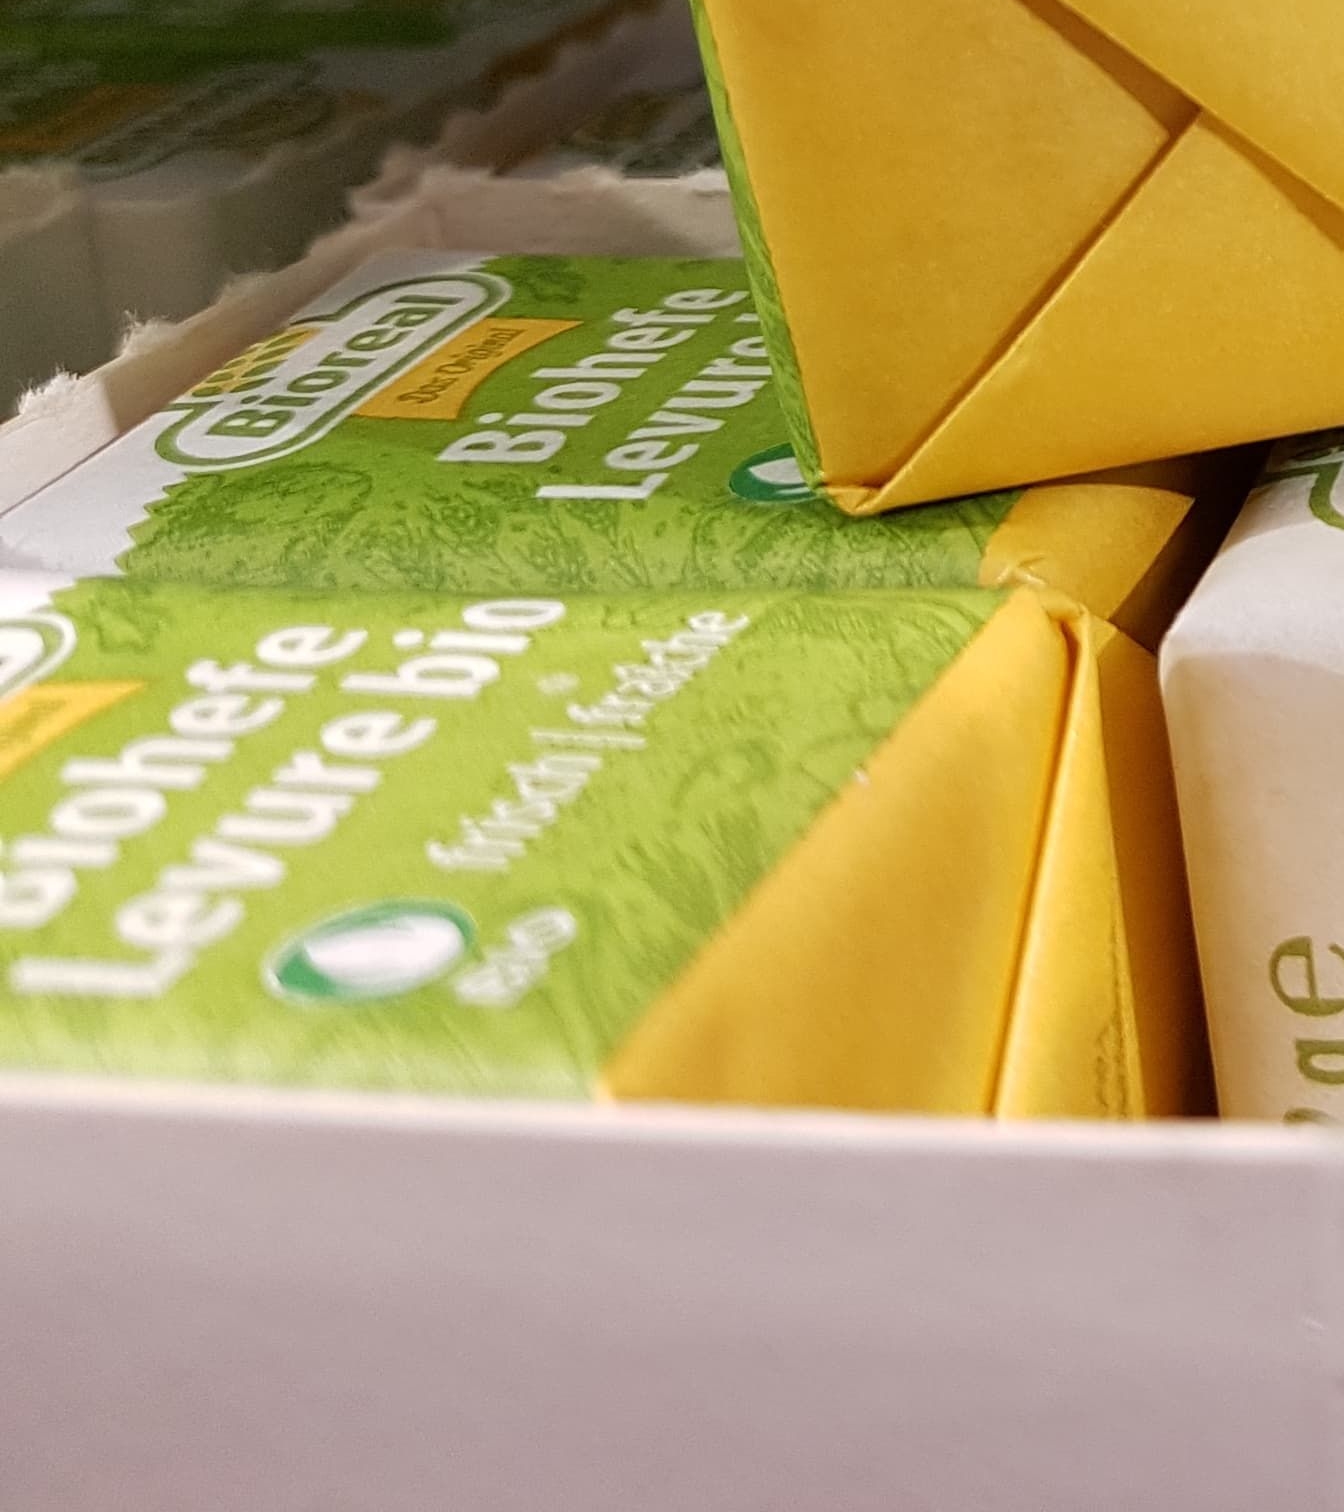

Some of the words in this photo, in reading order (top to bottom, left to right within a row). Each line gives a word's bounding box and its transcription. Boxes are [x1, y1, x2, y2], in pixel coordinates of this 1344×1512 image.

[206, 292, 464, 438] Bioreal
[435, 287, 752, 463] Biohefe
[12, 709, 437, 998] Levure
[338, 598, 567, 701] bio
